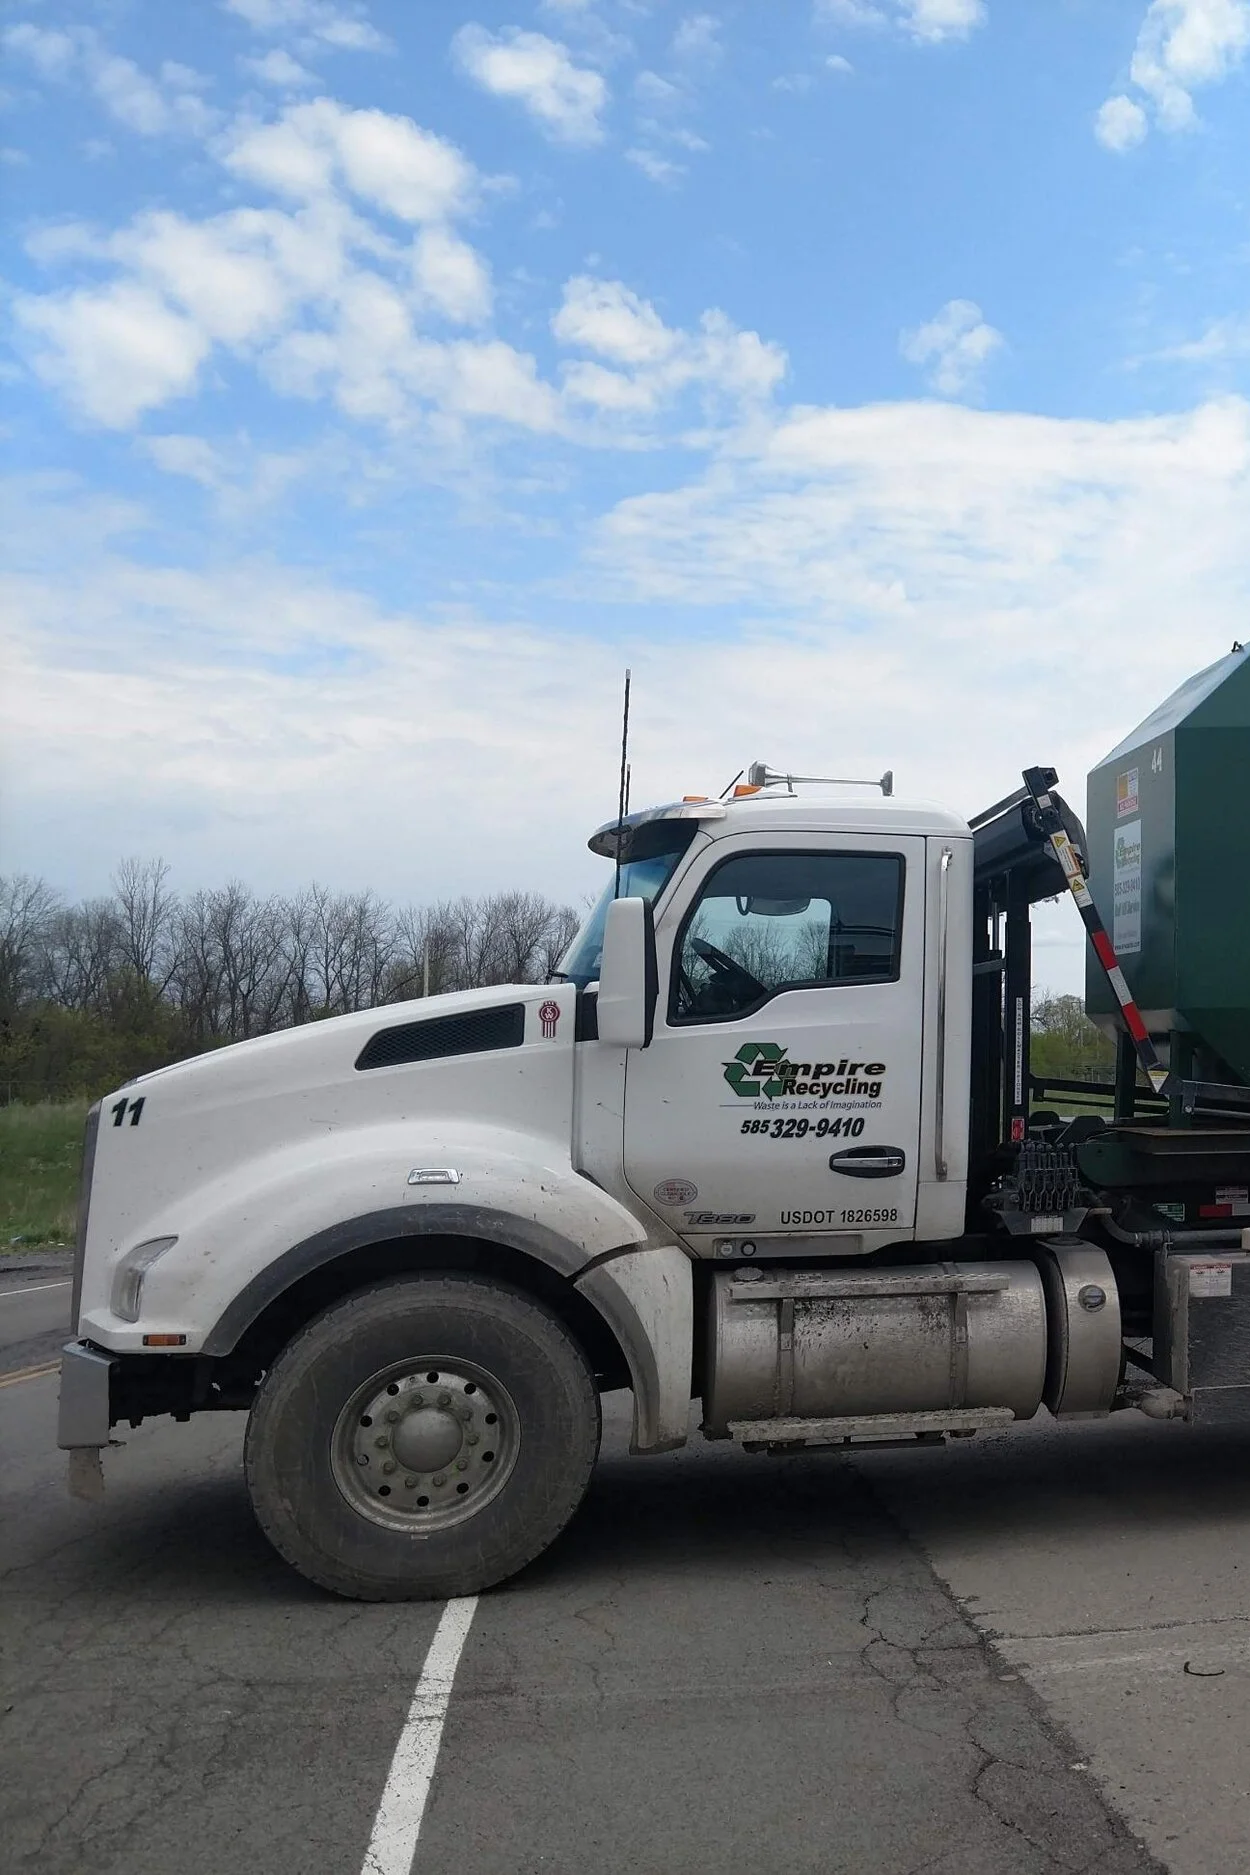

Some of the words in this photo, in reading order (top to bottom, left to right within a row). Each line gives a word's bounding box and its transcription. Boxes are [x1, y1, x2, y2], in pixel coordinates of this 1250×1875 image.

[1151, 747, 1162, 773] 44
[752, 1059, 886, 1080] Empire
[782, 1078, 882, 1099] Recycling
[112, 1097, 146, 1127] 11
[754, 1101, 780, 1111] Waste
[781, 1101, 789, 1110] is
[798, 1101, 818, 1110] Lack
[820, 1101, 830, 1110] of
[830, 1100, 882, 1112] Imagination
[740, 1119, 771, 1134] 585
[770, 1117, 865, 1139] 329-9410
[781, 1210, 835, 1224] USDOT
[840, 1208, 899, 1223] 1826598
